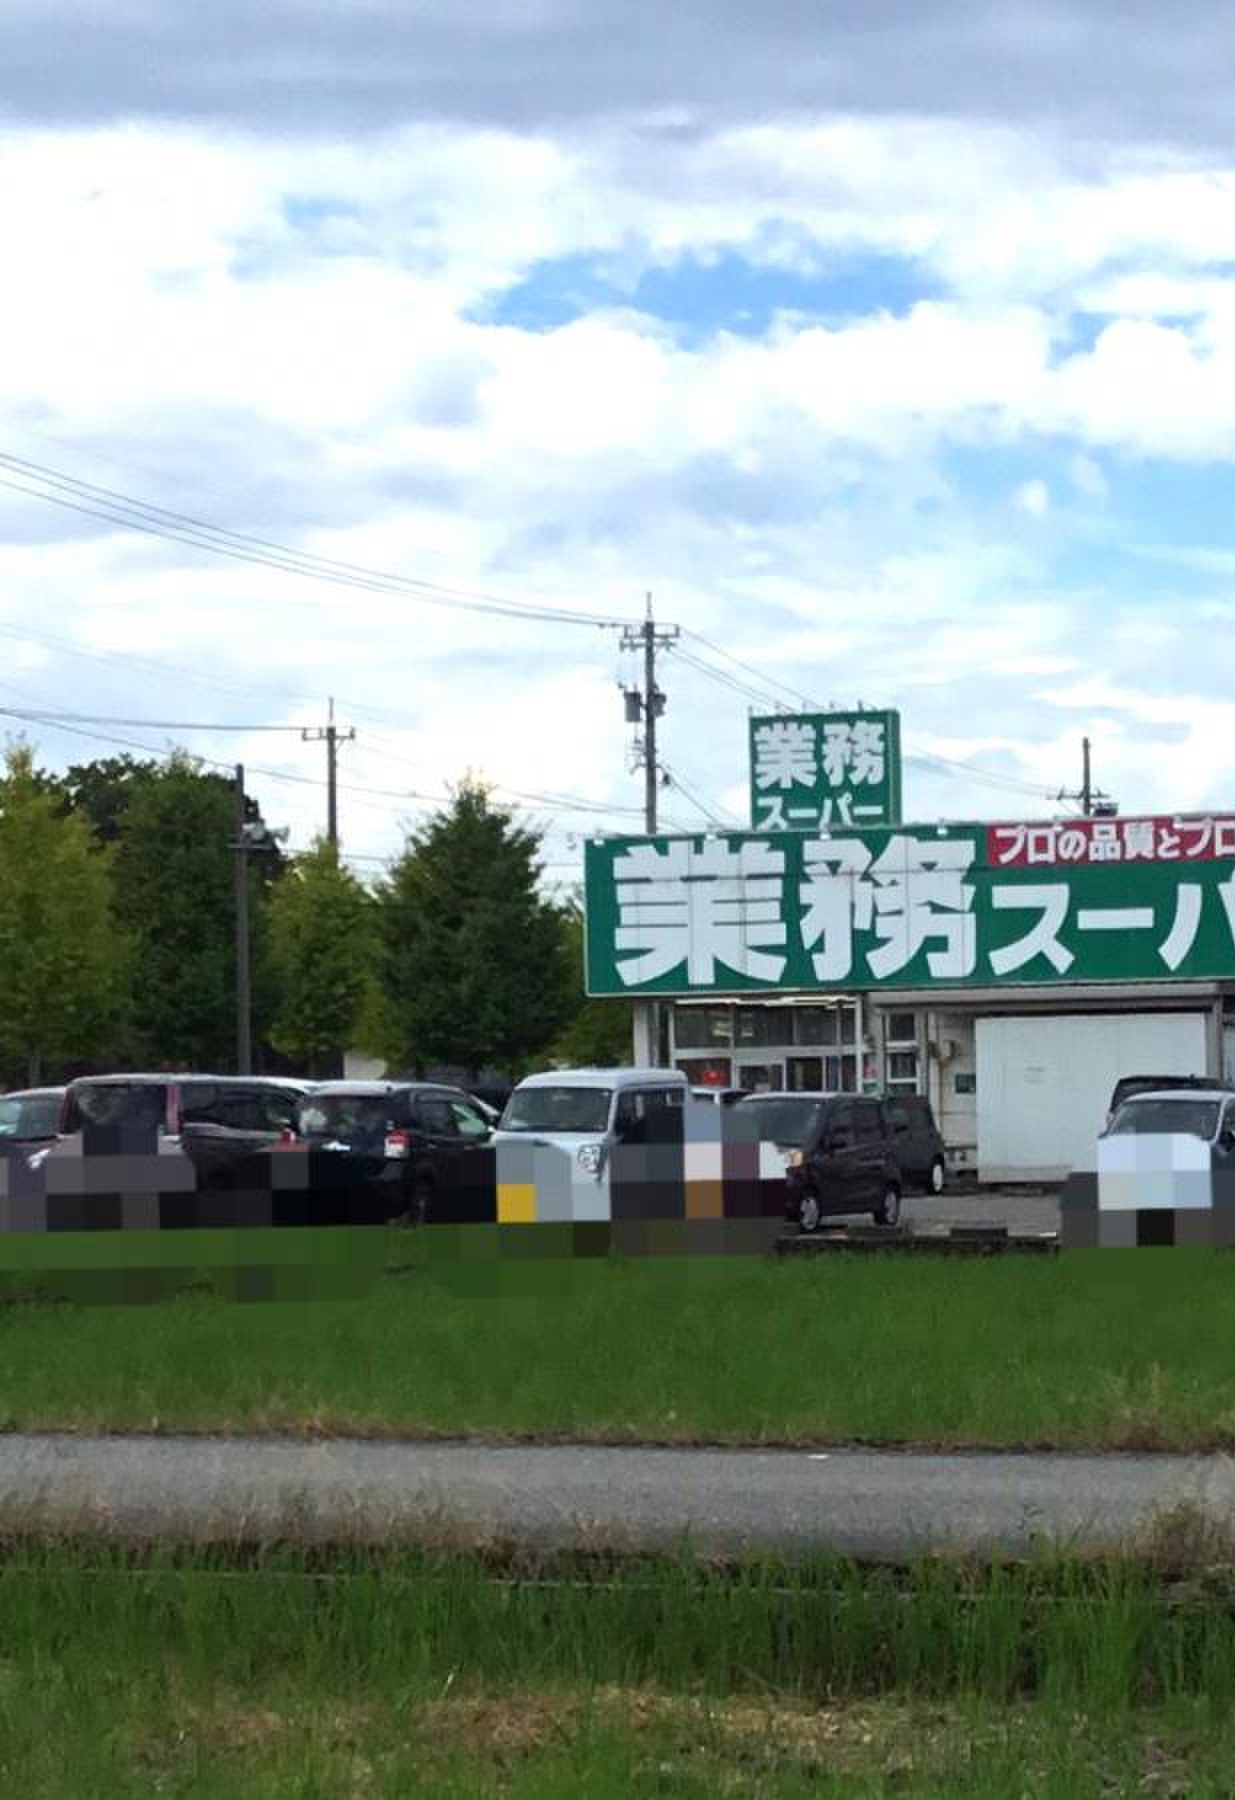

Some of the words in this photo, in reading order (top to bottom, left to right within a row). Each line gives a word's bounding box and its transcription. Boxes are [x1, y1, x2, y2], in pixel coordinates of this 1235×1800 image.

[754, 720, 885, 790] 業務
[756, 792, 883, 831] スーパー
